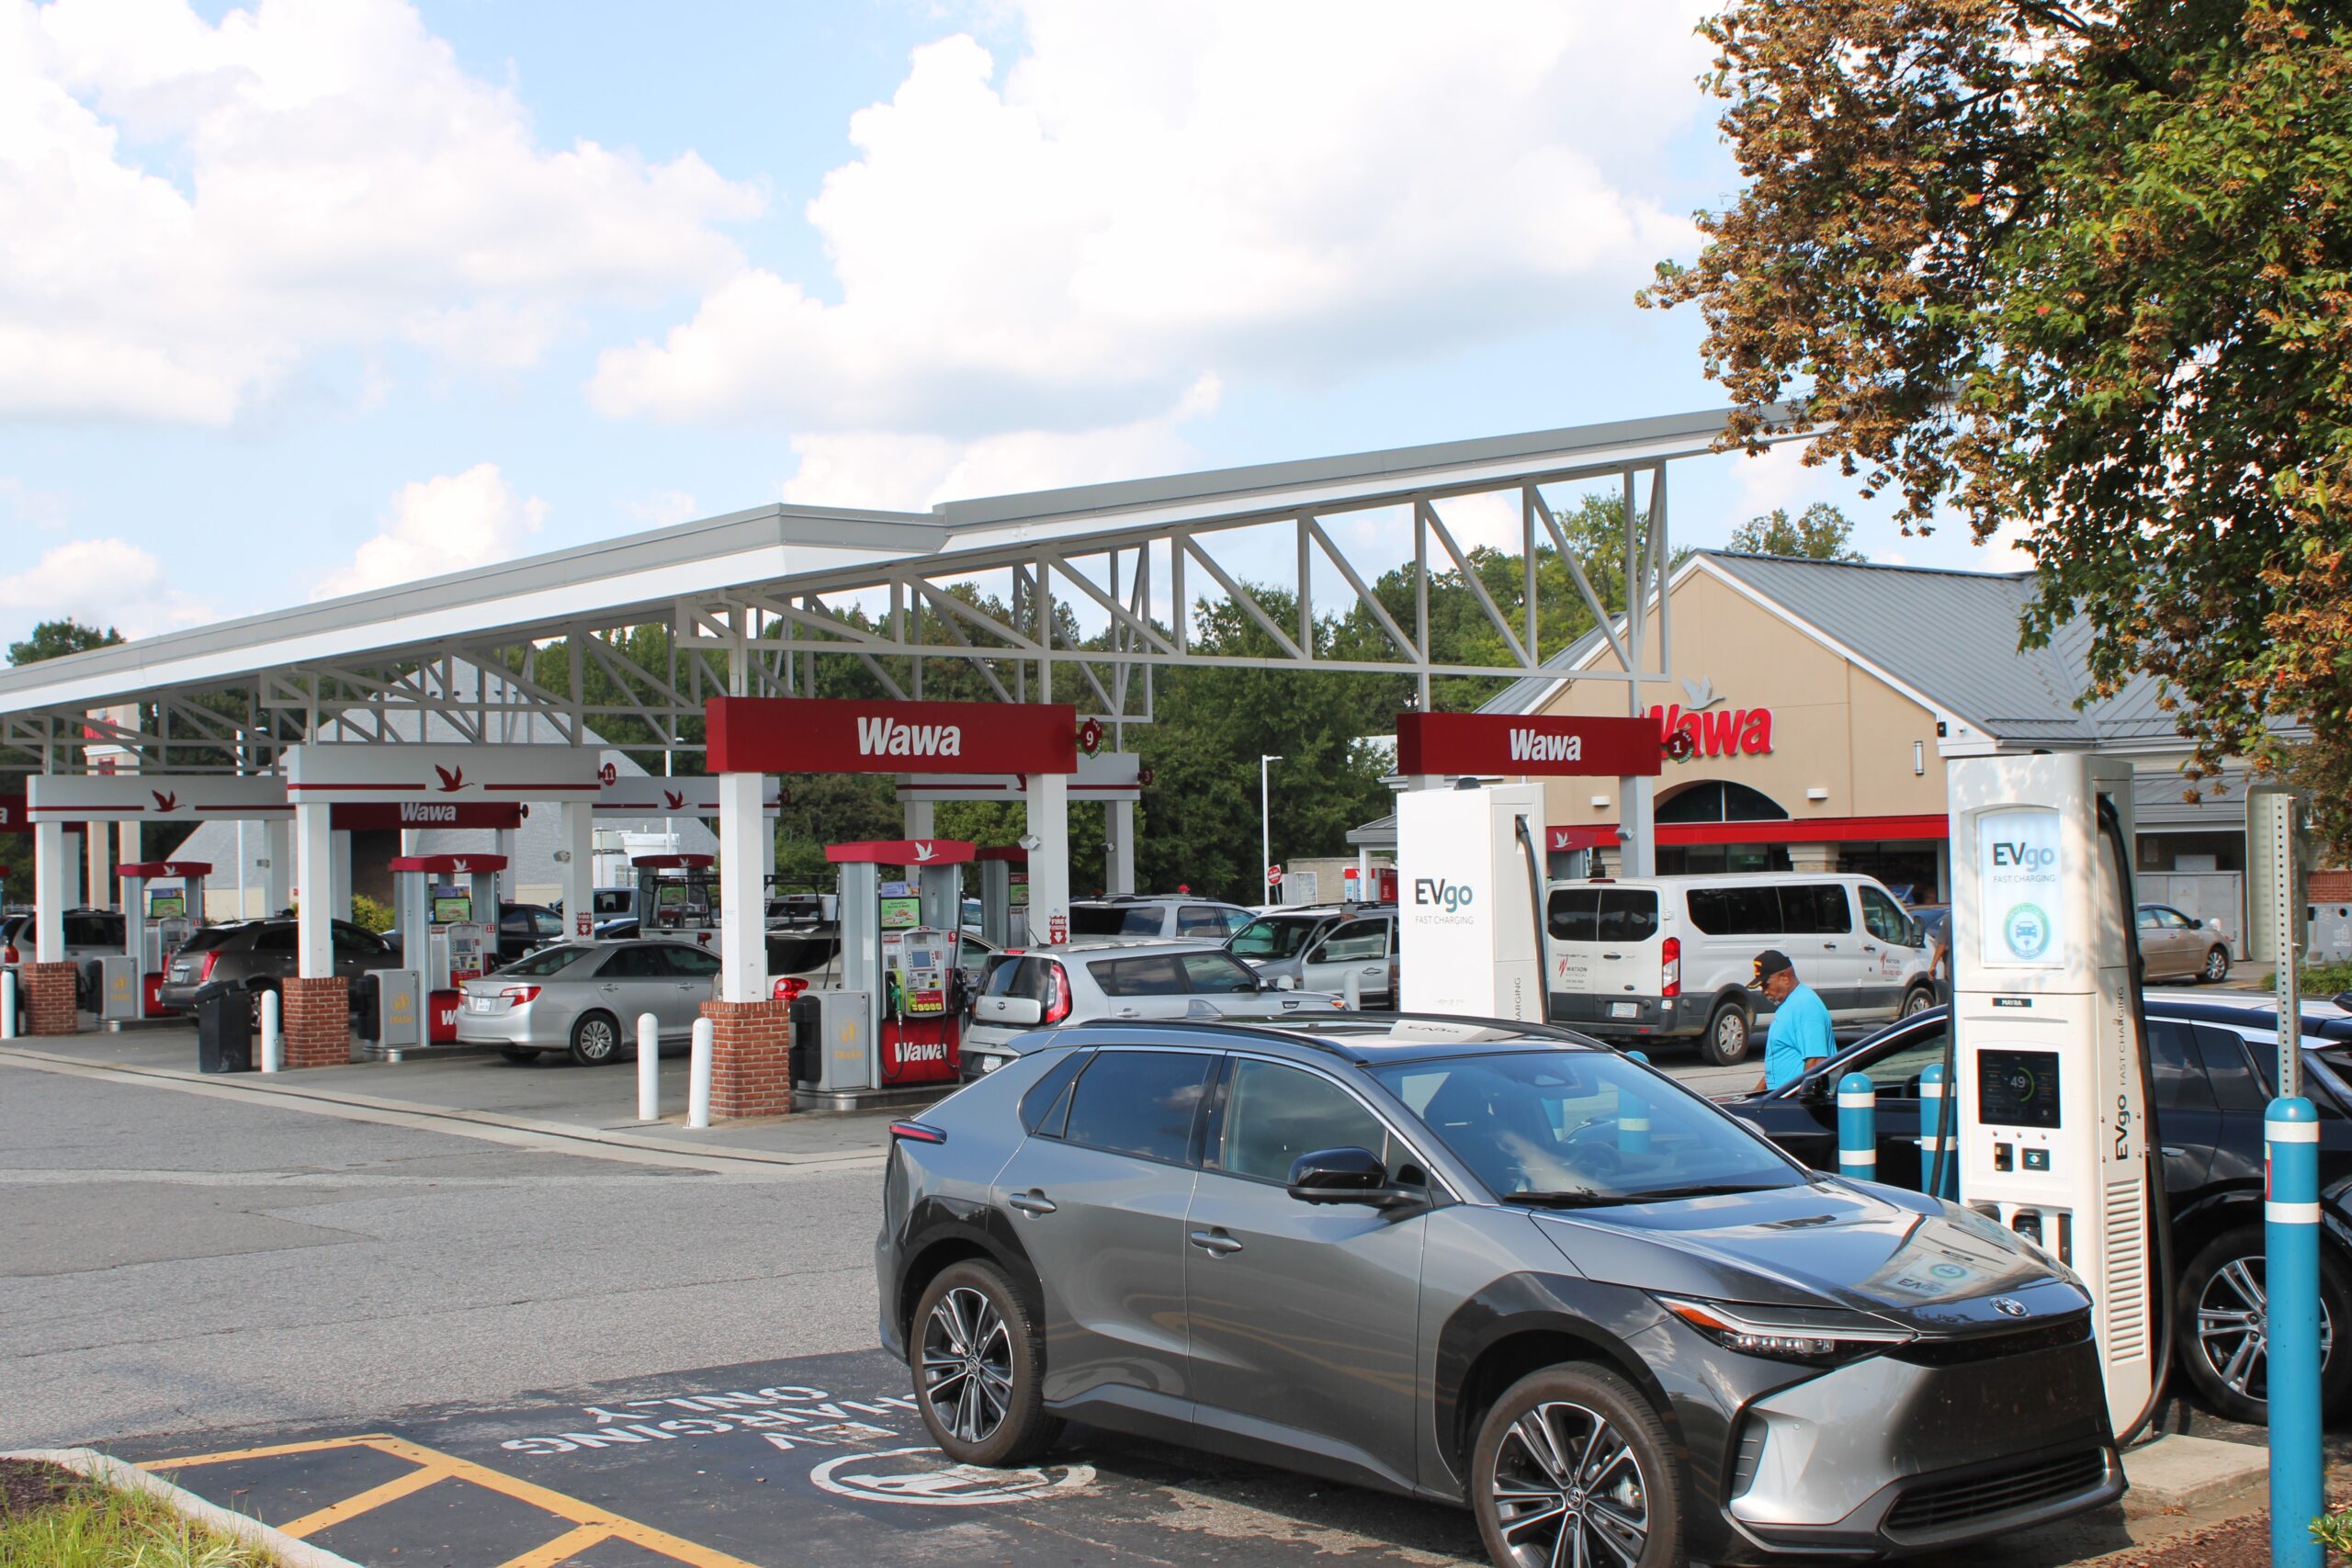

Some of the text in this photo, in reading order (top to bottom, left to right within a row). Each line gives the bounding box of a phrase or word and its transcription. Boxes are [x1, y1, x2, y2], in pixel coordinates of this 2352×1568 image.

[857, 716, 961, 756] Wawa
[1086, 730, 1093, 746] 9
[1510, 728, 1581, 761] Wawa
[1673, 740, 1682, 753] 1
[604, 768, 615, 781] 11
[400, 802, 457, 821] Wawa
[1993, 841, 2054, 873] EVgo
[2013, 874, 2056, 883] CHARGING
[1415, 878, 1473, 913] EVgo
[1415, 915, 1475, 925] FAST CHARGING
[2117, 987, 2126, 1053] CHARGING
[894, 1042, 947, 1063] Wawa
[2010, 1076, 2026, 1089] 49
[2115, 1094, 2131, 1161] EVgo
[582, 1385, 829, 1424] ONLY
[501, 1393, 919, 1455] HARGING
[761, 1421, 899, 1451] EV
